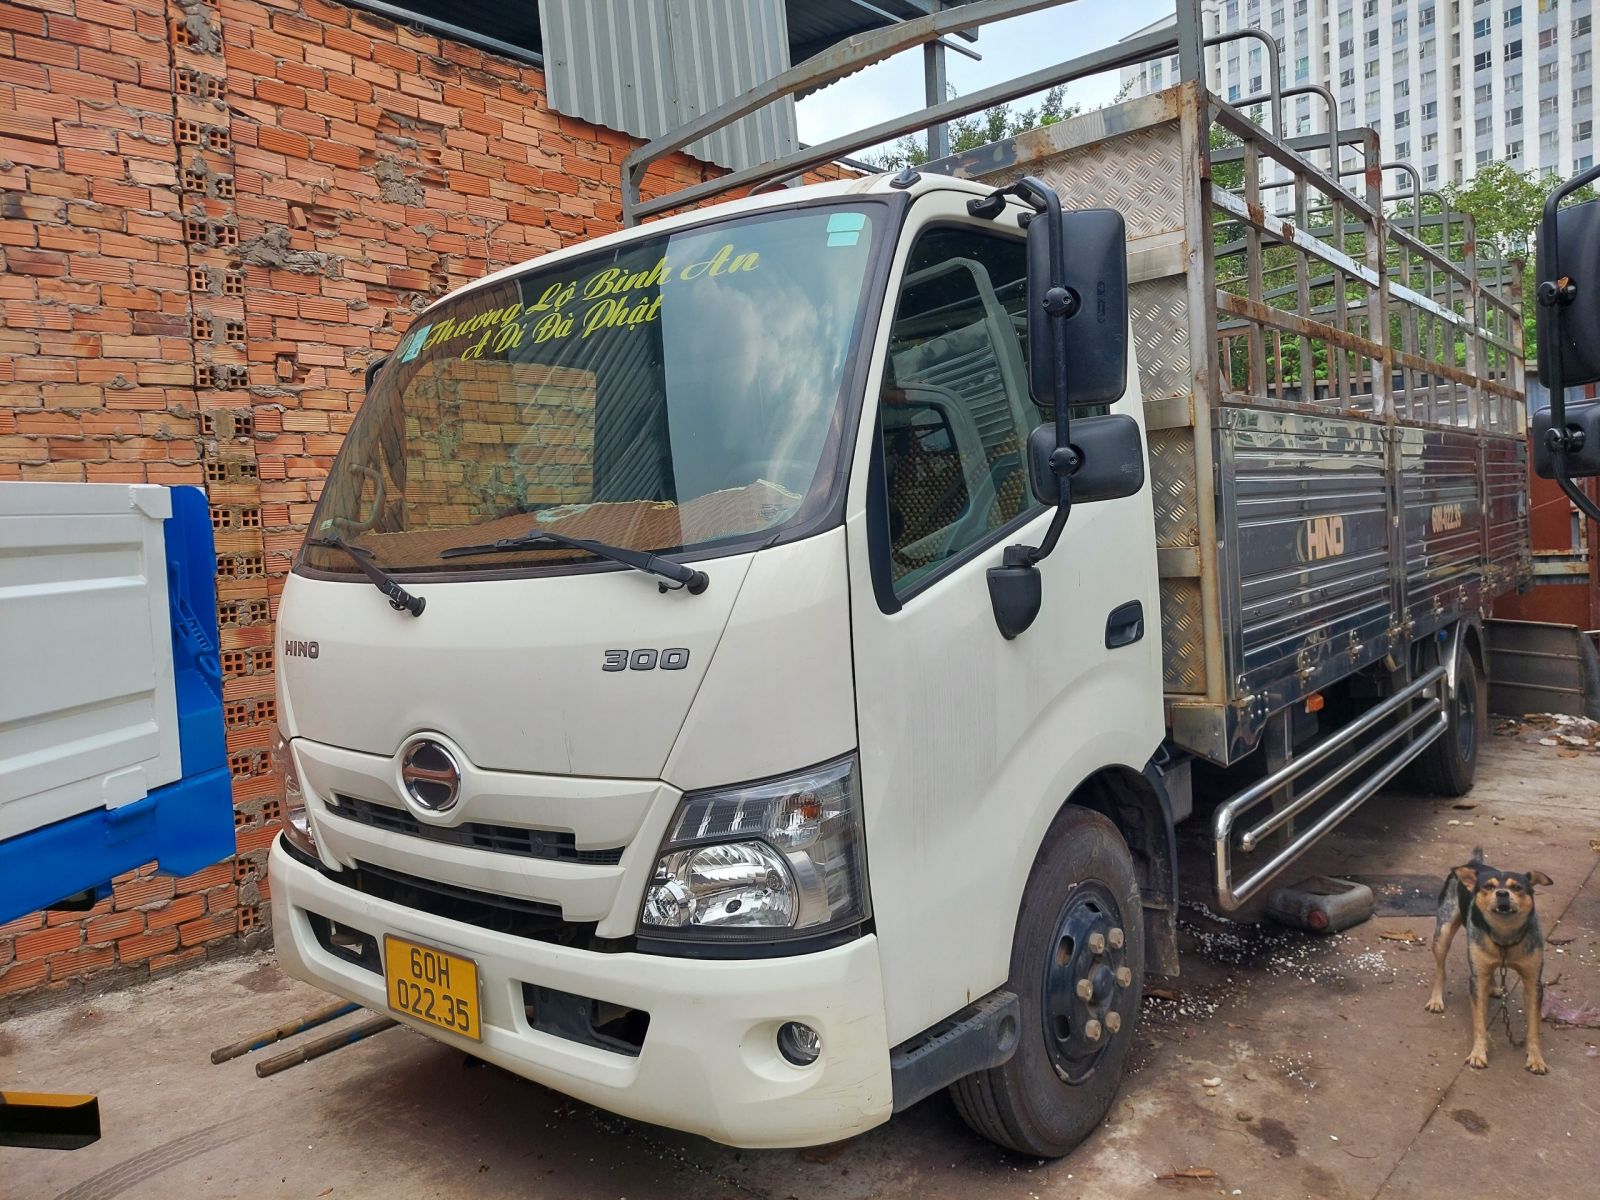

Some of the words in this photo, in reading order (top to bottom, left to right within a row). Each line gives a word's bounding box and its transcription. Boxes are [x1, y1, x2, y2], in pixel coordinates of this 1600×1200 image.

[422, 302, 524, 351] Thượng
[525, 280, 578, 315] Lộ
[680, 244, 760, 281] An
[461, 329, 492, 361] A
[492, 322, 528, 353] Di
[532, 312, 575, 344] Đà
[582, 293, 665, 340] Phật
[1307, 516, 1345, 561] HINO
[285, 640, 320, 660] HINO
[602, 647, 690, 672] 300
[410, 947, 451, 990] 60H
[397, 978, 470, 1032] 022.35
